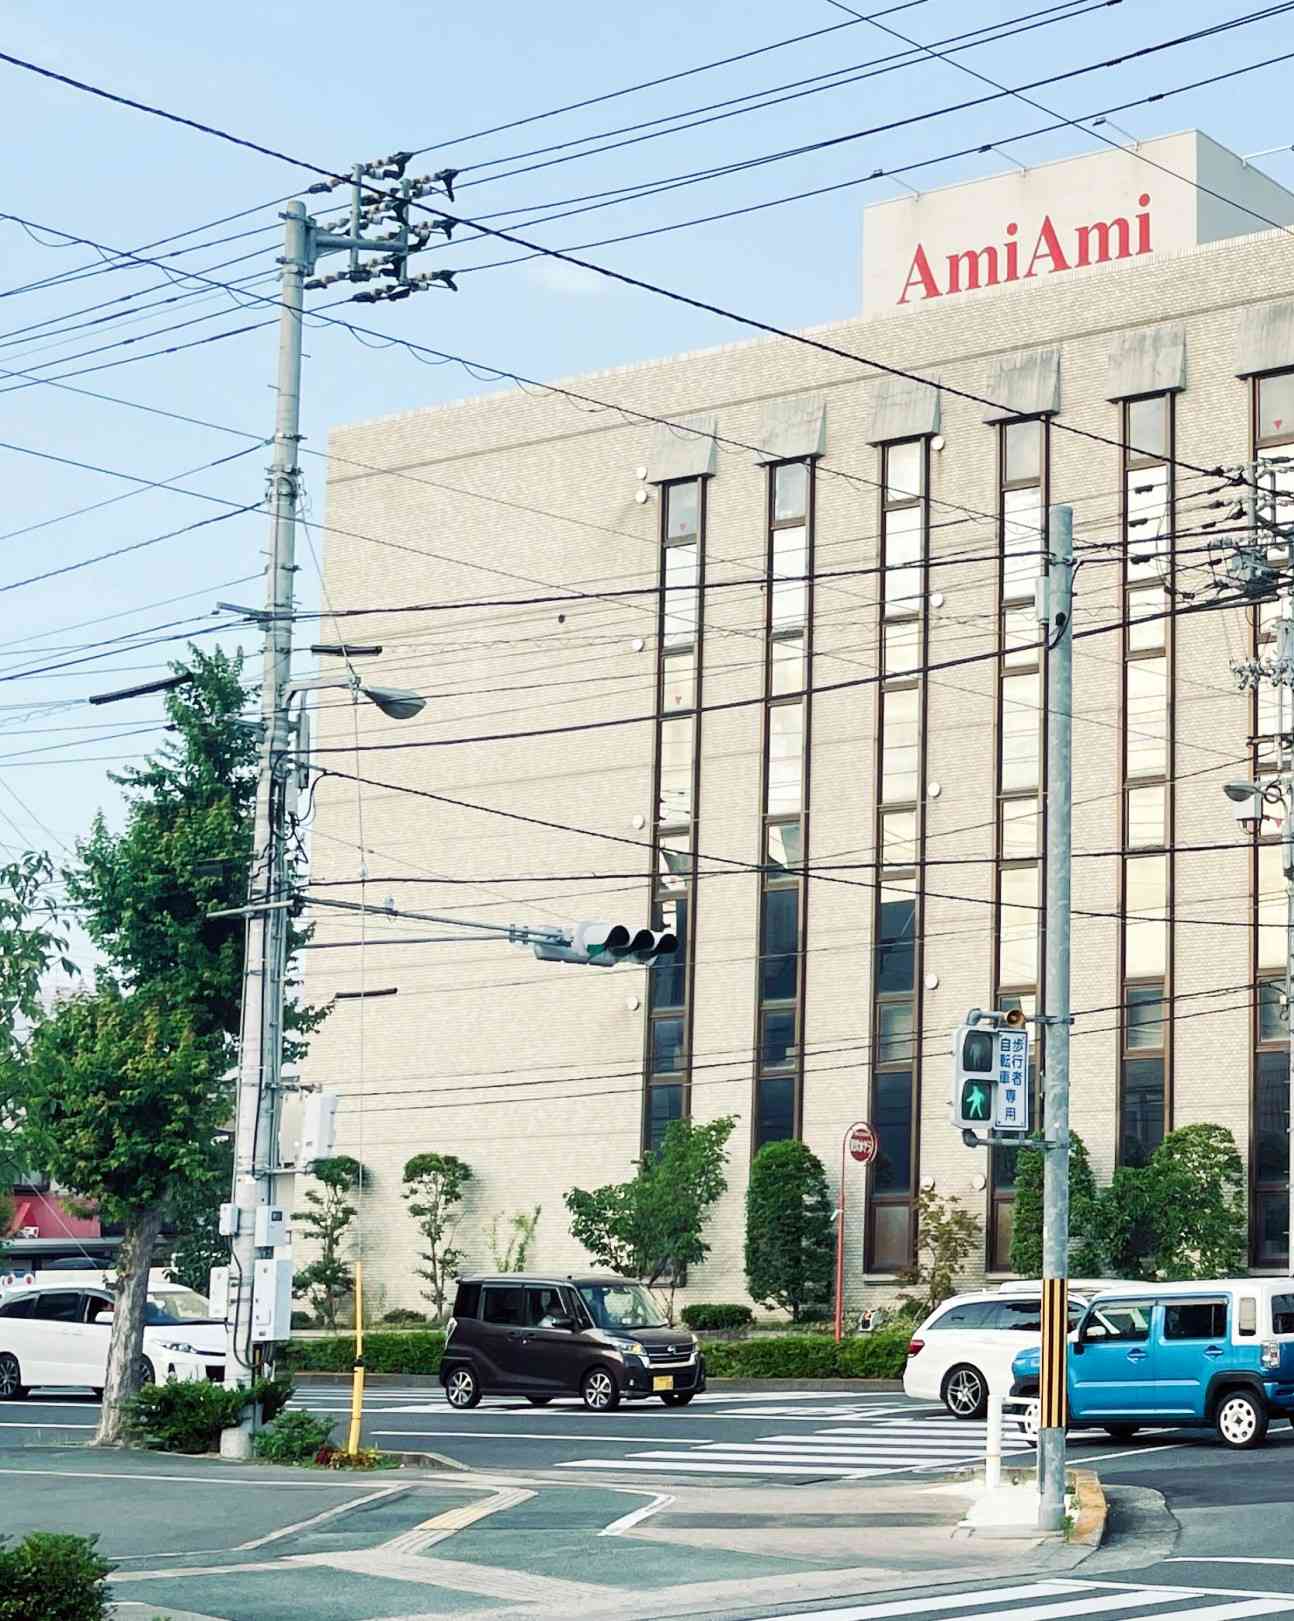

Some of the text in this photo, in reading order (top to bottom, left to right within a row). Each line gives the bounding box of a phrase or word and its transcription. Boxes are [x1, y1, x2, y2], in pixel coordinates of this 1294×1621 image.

[897, 193, 1153, 305] AmiAmi
[1000, 1038, 1011, 1083] 自転車
[1012, 1039, 1024, 1086] 歩行者
